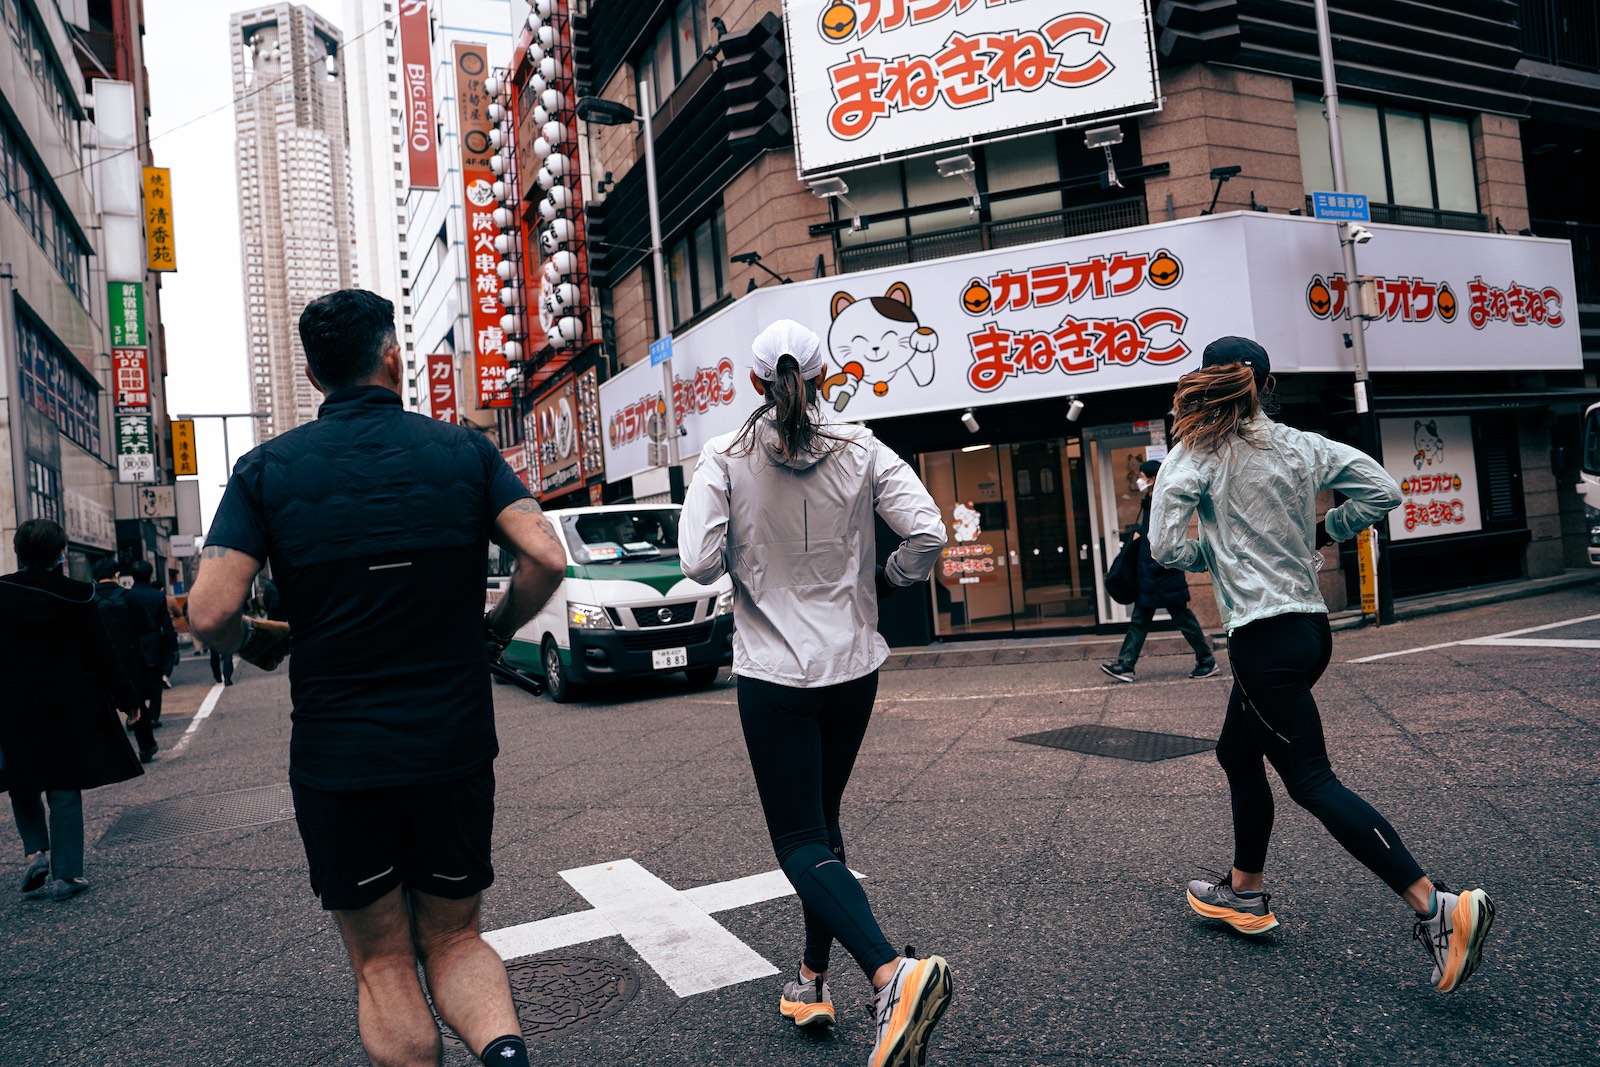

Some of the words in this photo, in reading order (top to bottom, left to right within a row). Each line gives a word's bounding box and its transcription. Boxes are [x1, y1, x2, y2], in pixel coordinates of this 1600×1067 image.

[407, 63, 426, 98] BIG
[828, 13, 1113, 140] まねきねこ
[412, 101, 430, 152] ECHO
[1318, 195, 1364, 209] 三番街通り
[472, 212, 499, 314] 炭火串焼き
[990, 253, 1150, 313] カラオケ
[122, 284, 139, 345] 新宿整骨院
[1330, 274, 1438, 321] カオケ
[1467, 277, 1565, 329] まねきねこ
[114, 325, 122, 345] 3F
[969, 310, 1190, 391] まねきねこ
[114, 350, 145, 359] スマホ
[120, 358, 140, 367] PC
[481, 366, 506, 377] 24H
[671, 354, 738, 428] まねきねこ
[132, 472, 145, 480] 1F
[1409, 474, 1454, 494] カラオケ
[1403, 500, 1466, 532] まねきねこ
[948, 545, 985, 557] カラオケ
[943, 558, 995, 577] まねきねこ
